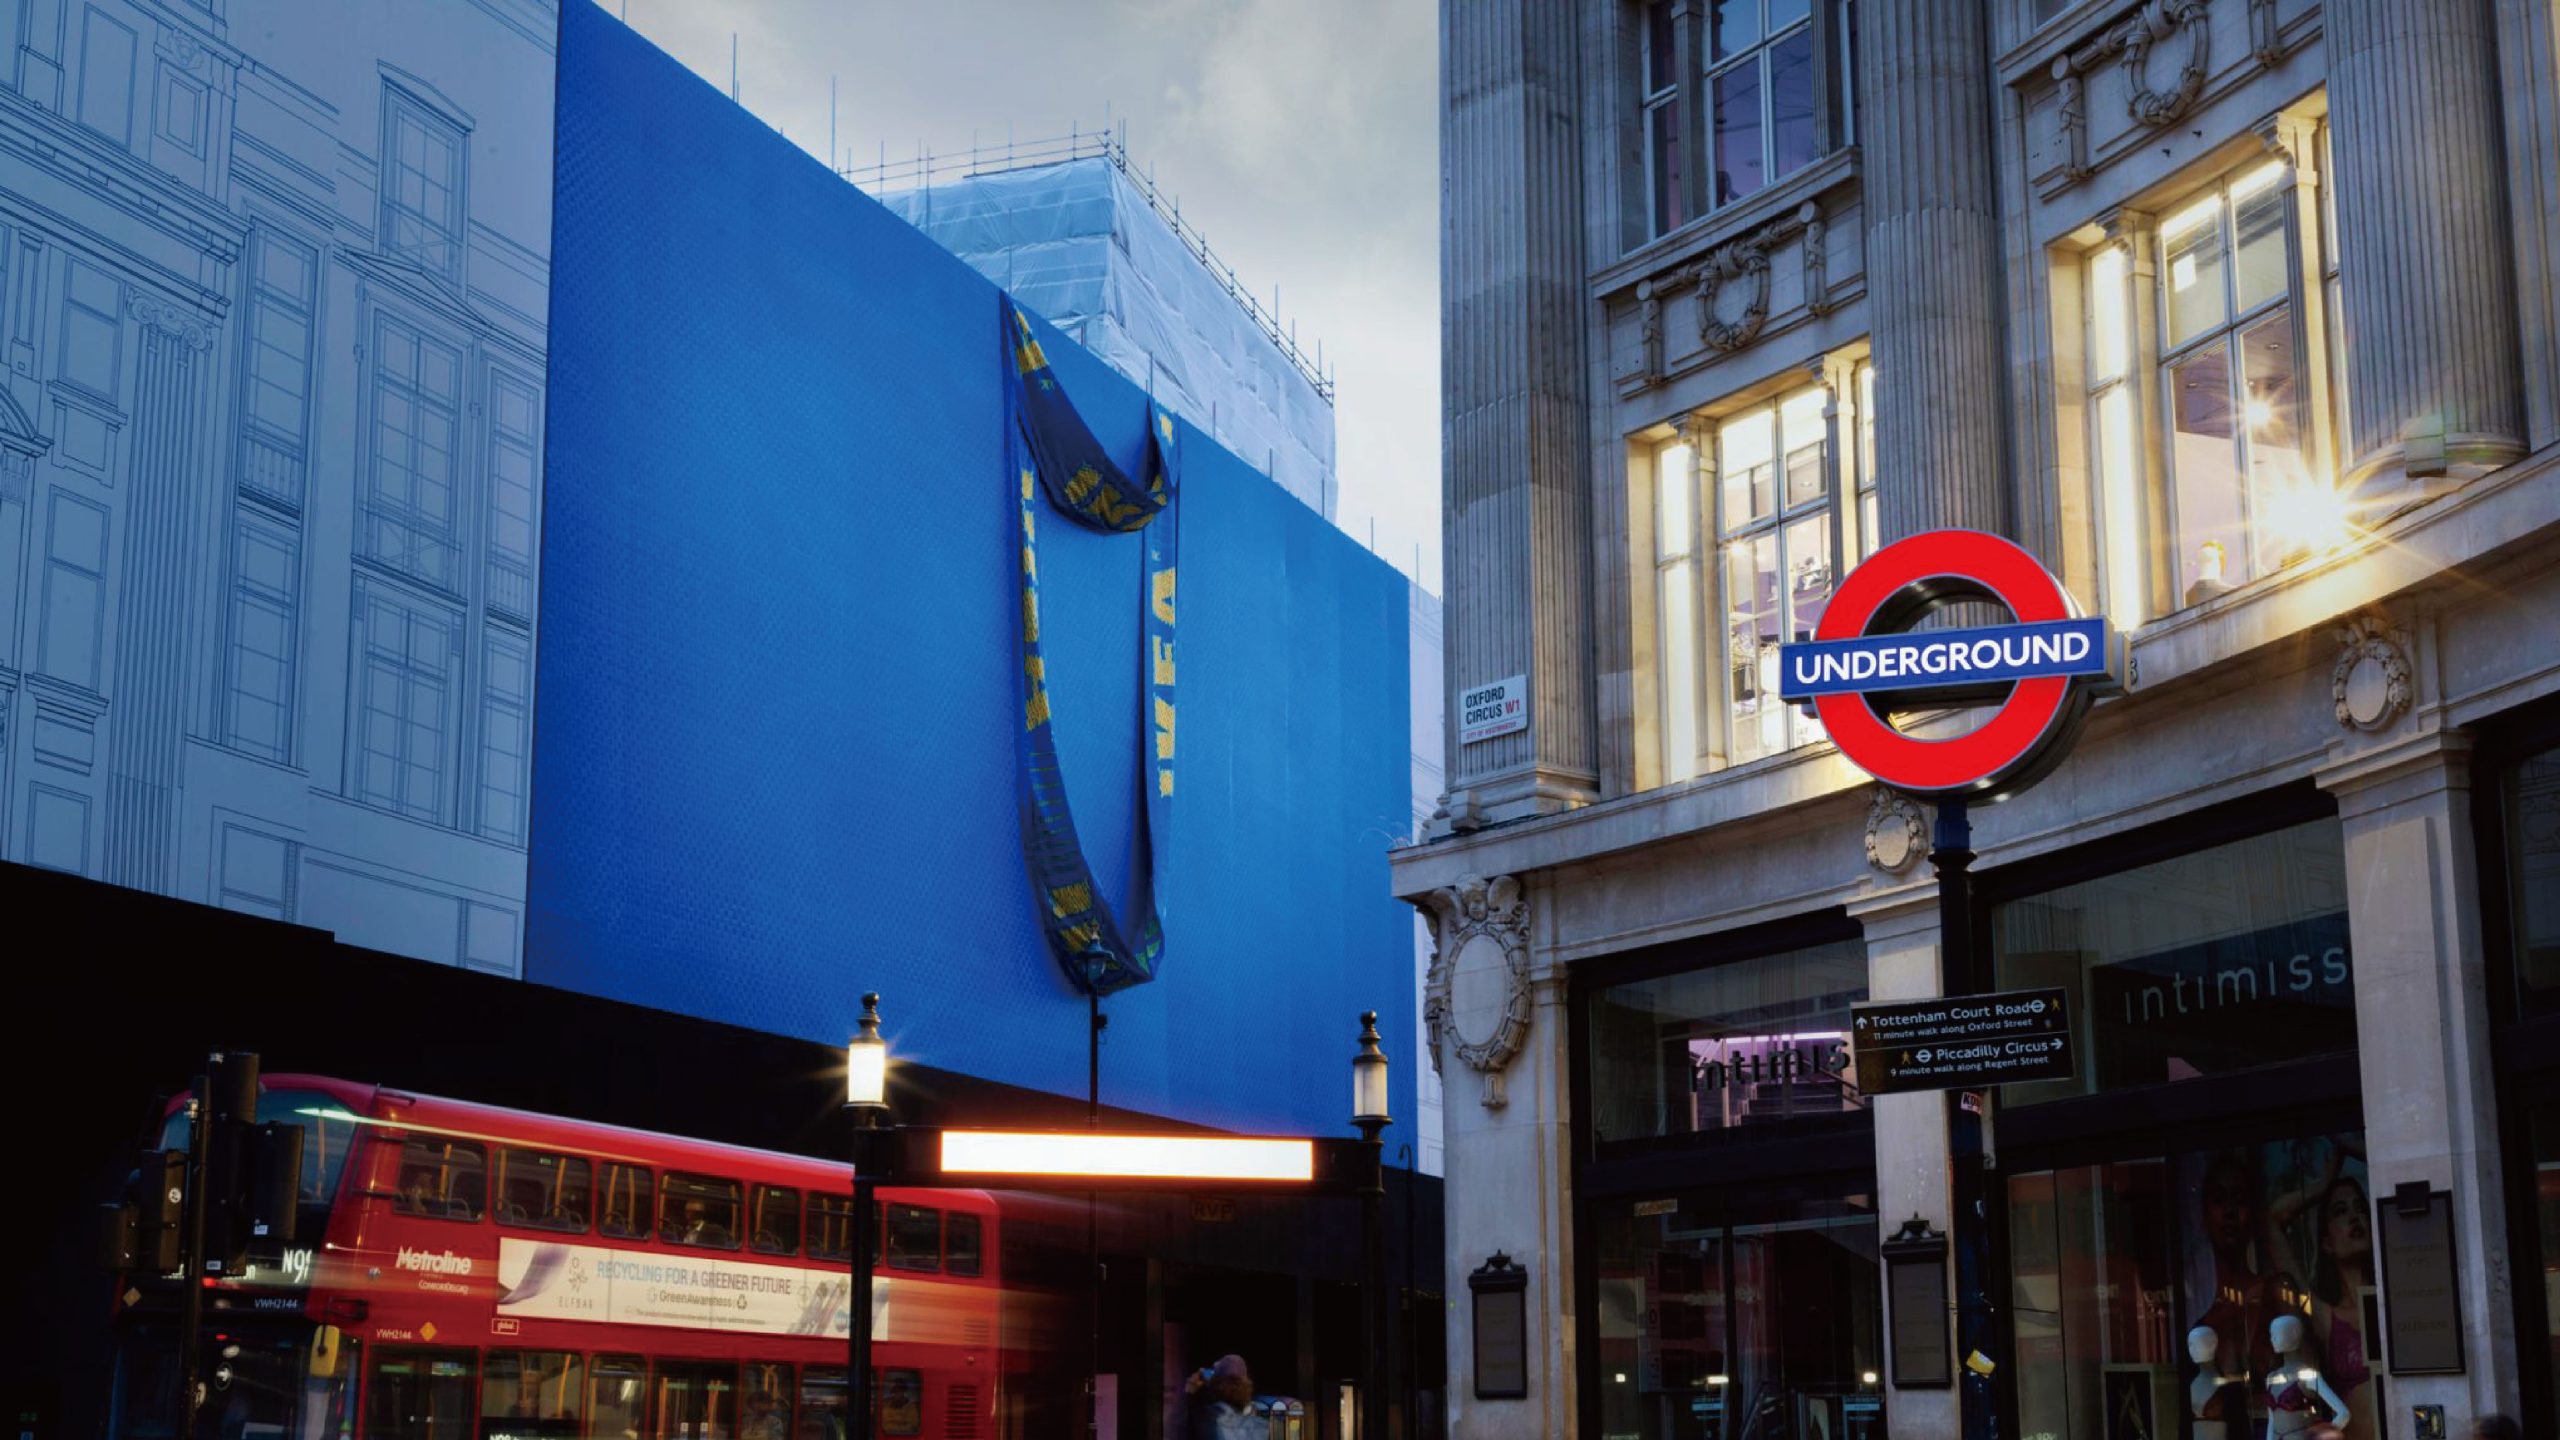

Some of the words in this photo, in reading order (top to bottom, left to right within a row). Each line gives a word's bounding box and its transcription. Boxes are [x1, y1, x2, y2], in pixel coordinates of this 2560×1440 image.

[1794, 631, 2091, 685] UNDERGROUND
[1465, 685, 1505, 709] OXFORD
[1466, 703, 1503, 725] CIRCUS
[1505, 698, 1520, 714] W1
[2124, 946, 2349, 1025] intimiss
[1871, 1010, 1947, 1028] Tottenham
[1950, 1005, 1991, 1021] Court
[1995, 1001, 2030, 1016] Road
[1873, 1032, 1882, 1040] 11
[1883, 1028, 1915, 1039] minute
[1917, 1026, 1939, 1036] walk
[1940, 1024, 1966, 1035] along
[1968, 1021, 2001, 1032] Oxford
[2003, 1018, 2034, 1028] Street
[1936, 1044, 2001, 1060] Piccadilly
[2005, 1040, 2048, 1055] Circus
[1890, 1068, 1897, 1077] 9
[1899, 1064, 1931, 1075] minute
[1933, 1062, 1955, 1073] walk
[1957, 1061, 1982, 1072] along
[1985, 1058, 2018, 1069] Regent
[2020, 1055, 2049, 1066] Street
[1194, 1200, 1232, 1218] RVP
[395, 1245, 472, 1275] Metroline
[597, 1260, 662, 1283] RECYCLING
[665, 1267, 688, 1284] FOR
[691, 1269, 699, 1286] A
[702, 1272, 749, 1291] GREENER
[751, 1276, 792, 1295] FUTURE
[254, 1298, 298, 1310] VWH2144
[659, 1289, 733, 1308] GreenAwareness
[376, 1328, 412, 1340] VWH2144
